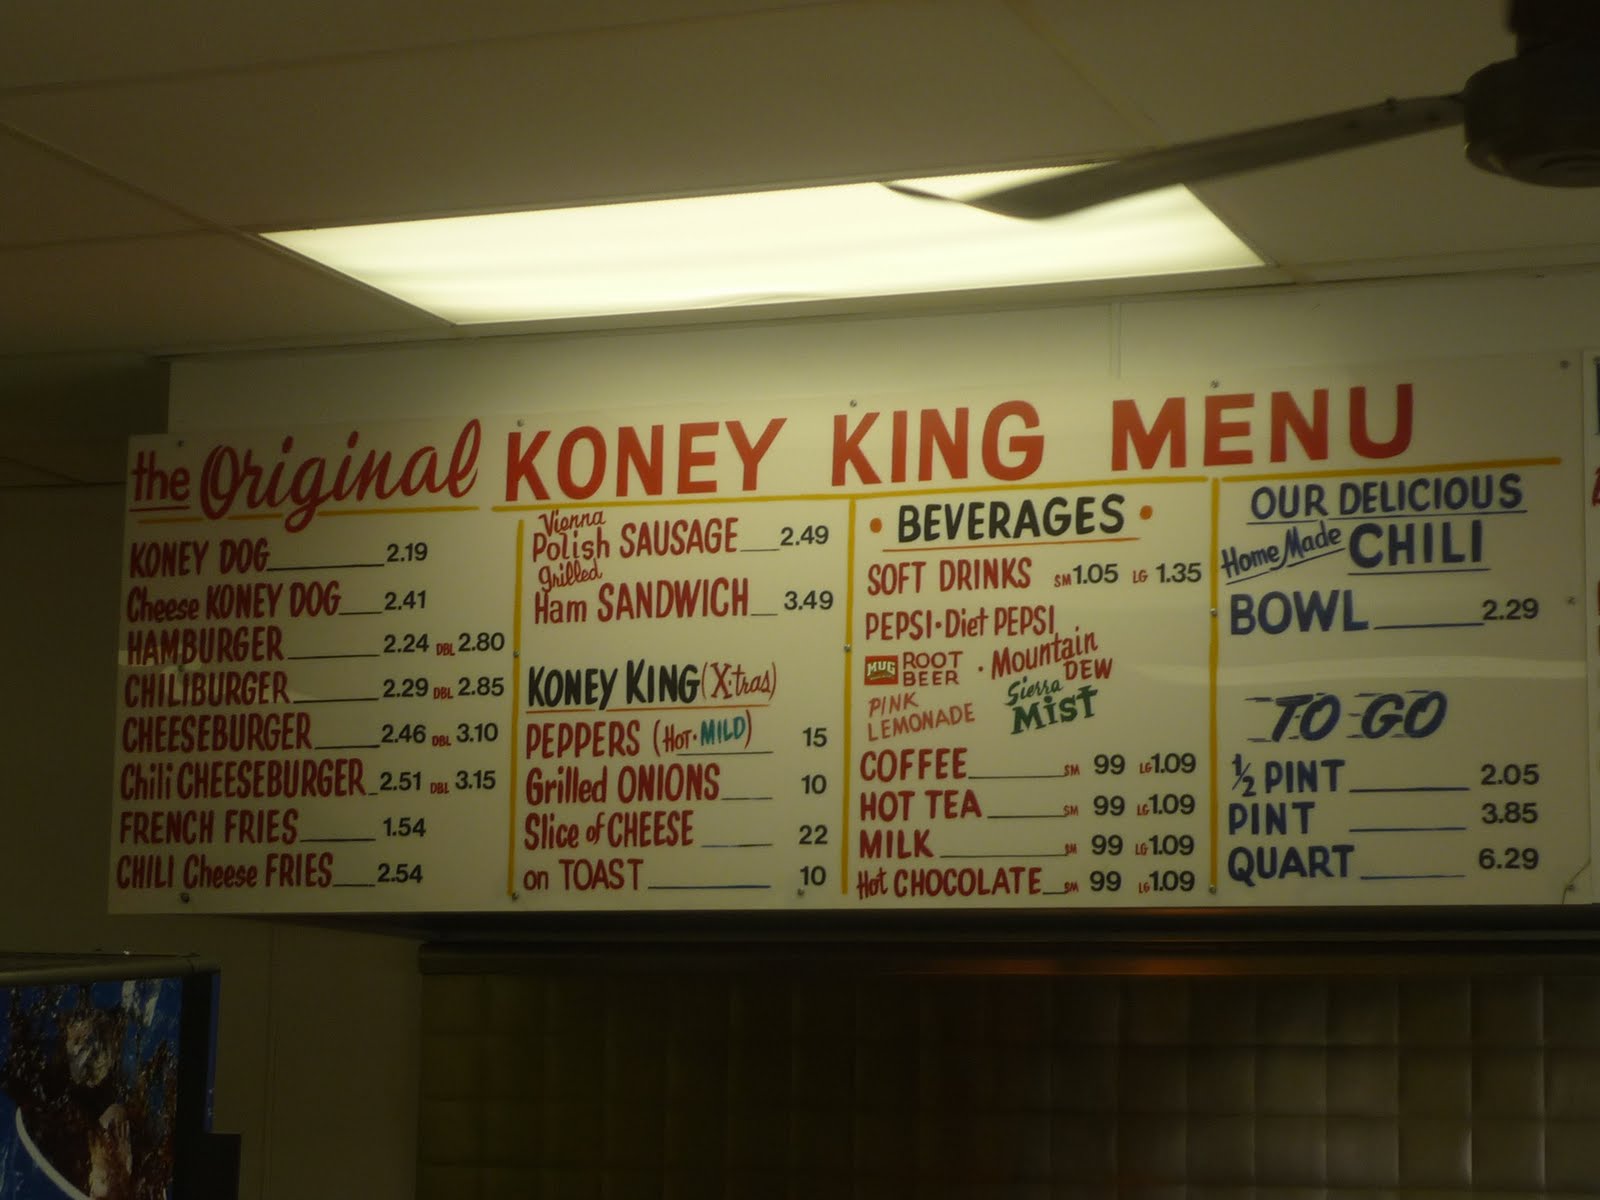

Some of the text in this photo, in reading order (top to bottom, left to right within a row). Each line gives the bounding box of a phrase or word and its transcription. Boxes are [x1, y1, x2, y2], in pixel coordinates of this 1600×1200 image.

[131, 383, 1414, 534] the Original KONEY KING MENU
[1251, 472, 1523, 520] OUR DELICIOUS
[538, 509, 606, 536] Vienna
[898, 493, 1125, 543] BEVERAGES
[129, 537, 428, 578] KONEY DOG 2.19
[532, 517, 829, 562] Polish SAUSAGE 2.49
[1349, 519, 1483, 569] CHILI
[538, 558, 603, 592] Grilled
[867, 556, 1202, 596] SOFT DRINKS SM 1.05 LG 1.35
[127, 580, 427, 624] Cheese KONEY DOG 2.41
[534, 577, 834, 625] Ham SANDWICH 3.49
[994, 605, 1055, 637] PEPSI
[1230, 589, 1539, 635] BOWL 2.29
[127, 625, 506, 666] HAMBURGER 2.24 DBL 2.80
[865, 651, 963, 677] MUG ROOT
[991, 626, 1099, 681] Mountain
[125, 670, 505, 708] CHILIBURGER 2.29 DBL 2.85
[528, 665, 618, 711] KONEY
[626, 658, 701, 706] KING
[902, 670, 960, 687] BEER
[1063, 658, 1113, 682] DEW
[868, 692, 919, 718] PINK
[1003, 675, 1064, 707] Sierra
[122, 712, 499, 754] CHEESEBURGER 2.46 DBL 3.10
[867, 702, 976, 742] LEMONADE
[1271, 690, 1448, 743] TO GO
[526, 719, 641, 760] PEPPERS
[802, 727, 827, 748] 15
[120, 758, 497, 801] Chili CHEESEBURGER 2.51 DBL 3.15
[526, 762, 827, 806] Grilled ONIONS 10
[860, 747, 1197, 783] COFFEE SM 99 LG 1.09
[1265, 759, 1345, 794] PINT
[1480, 763, 1540, 786] 2.05
[860, 789, 1196, 822] HOT TEA SM 99 LG 1.09
[1228, 801, 1539, 836] PINT 3.85
[120, 808, 427, 844] FRENCH FRIES 1.54
[524, 809, 828, 851] Slice of CHEESE 22
[859, 829, 1195, 859] MILK SM 99 LG 1.09
[116, 852, 424, 890] CHILI Cheese FRIES 2.54
[523, 858, 827, 891] on TOAST 10
[857, 867, 1196, 900] Hot CHOCOLATE SM 99 LG 1.09
[1228, 844, 1540, 887] QUART 6.29
